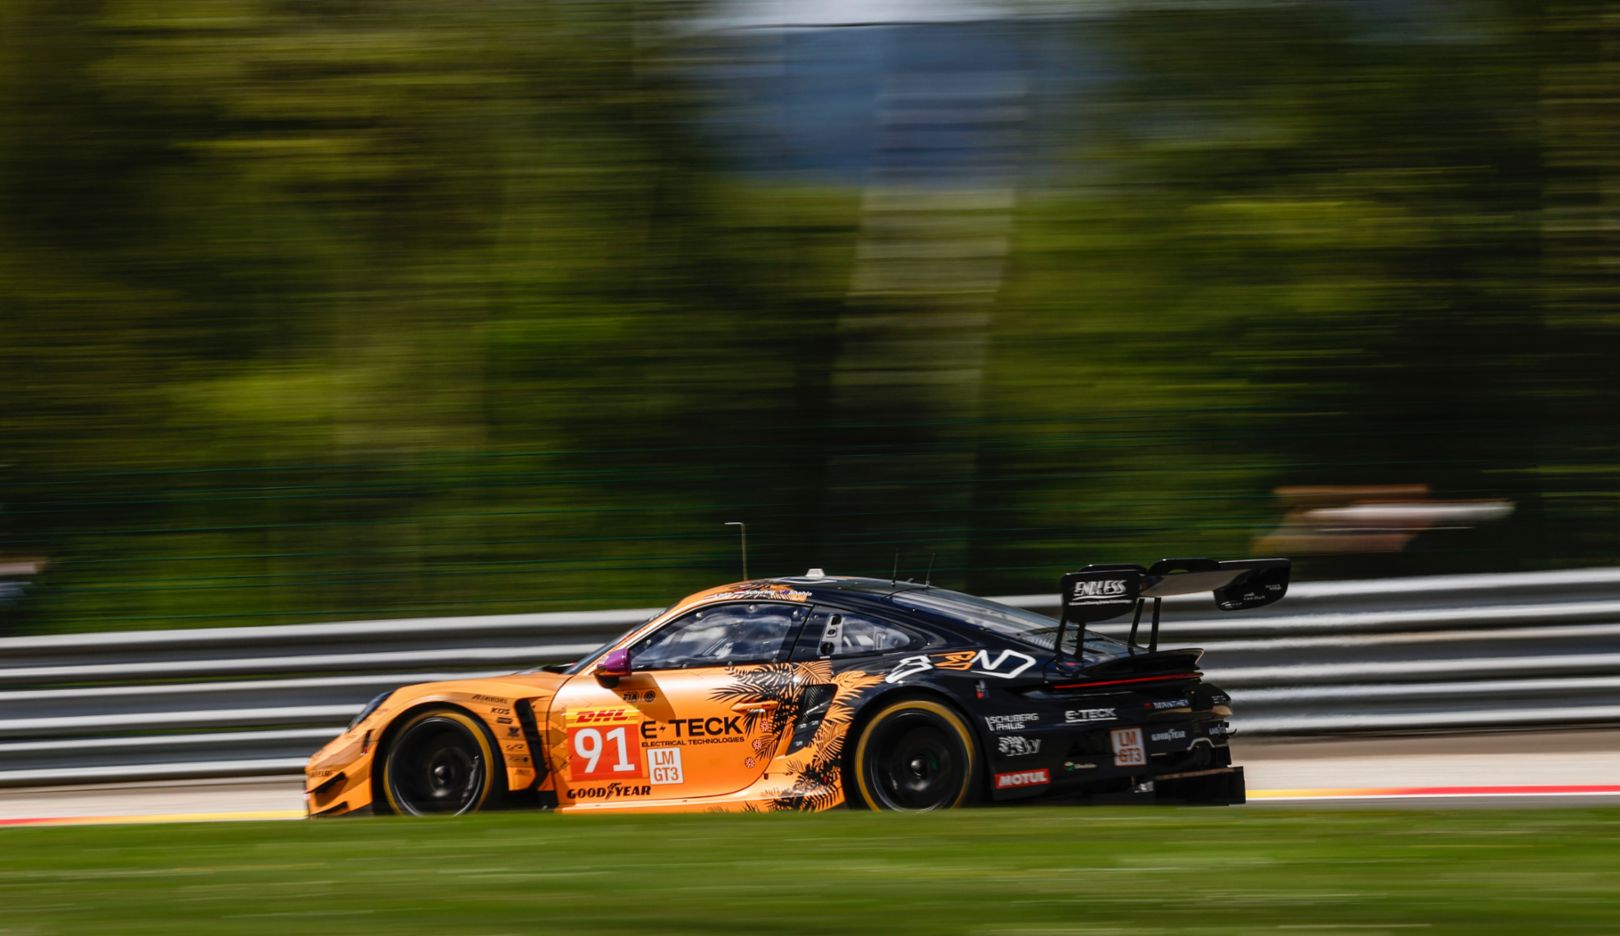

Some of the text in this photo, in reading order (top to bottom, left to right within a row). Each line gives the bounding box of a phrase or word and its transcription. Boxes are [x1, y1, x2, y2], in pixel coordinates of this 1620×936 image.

[576, 709, 628, 723] DHL
[641, 736, 745, 748] ELECTRICAL TECHNOLOGIES
[1119, 730, 1137, 747] LM
[574, 727, 636, 774] 91
[654, 750, 675, 766] LM
[1119, 747, 1142, 763] GT3
[653, 767, 679, 782] GT3
[999, 771, 1048, 787] MOTUL
